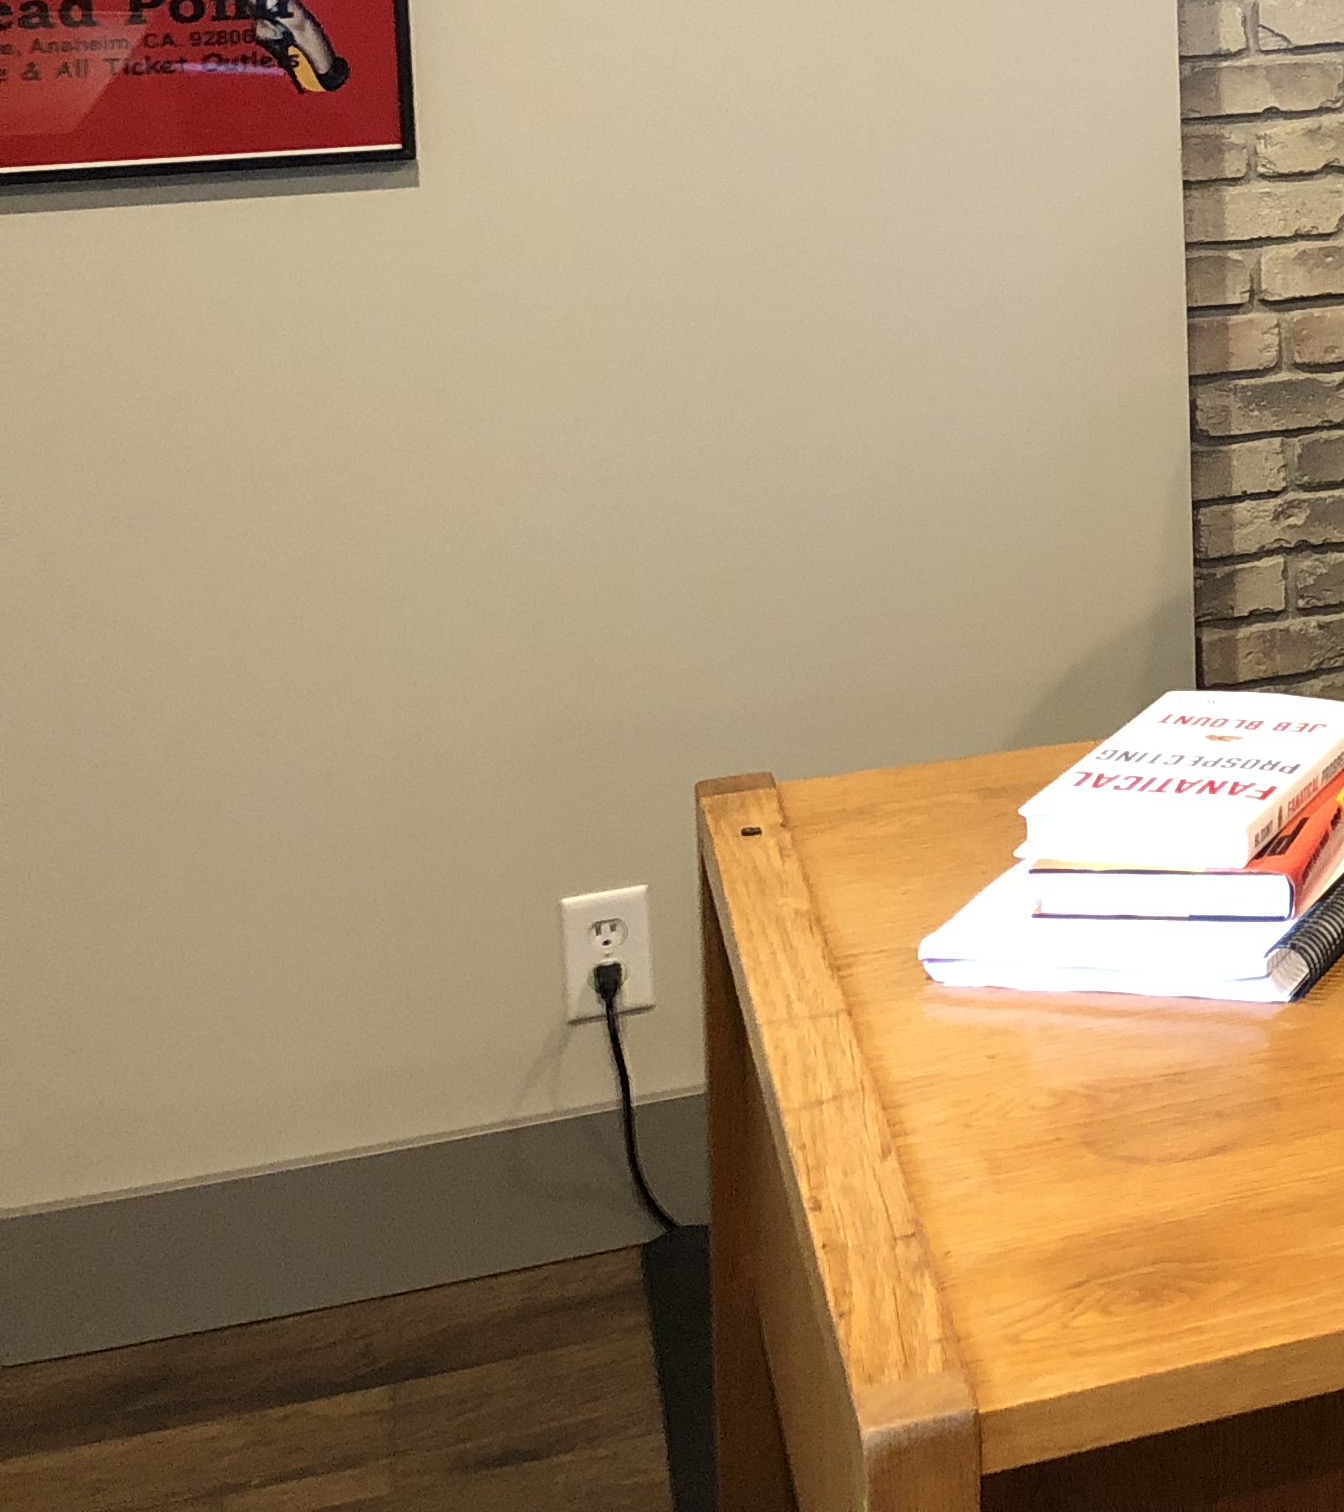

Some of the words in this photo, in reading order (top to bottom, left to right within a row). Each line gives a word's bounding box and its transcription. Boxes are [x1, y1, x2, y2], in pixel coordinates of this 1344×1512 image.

[202, 51, 300, 73] Outles
[1157, 713, 1265, 732] BLOUNT
[1273, 721, 1327, 734] JEB
[1096, 748, 1302, 775] PROSPECTING
[1072, 770, 1278, 801] FANATICAL
